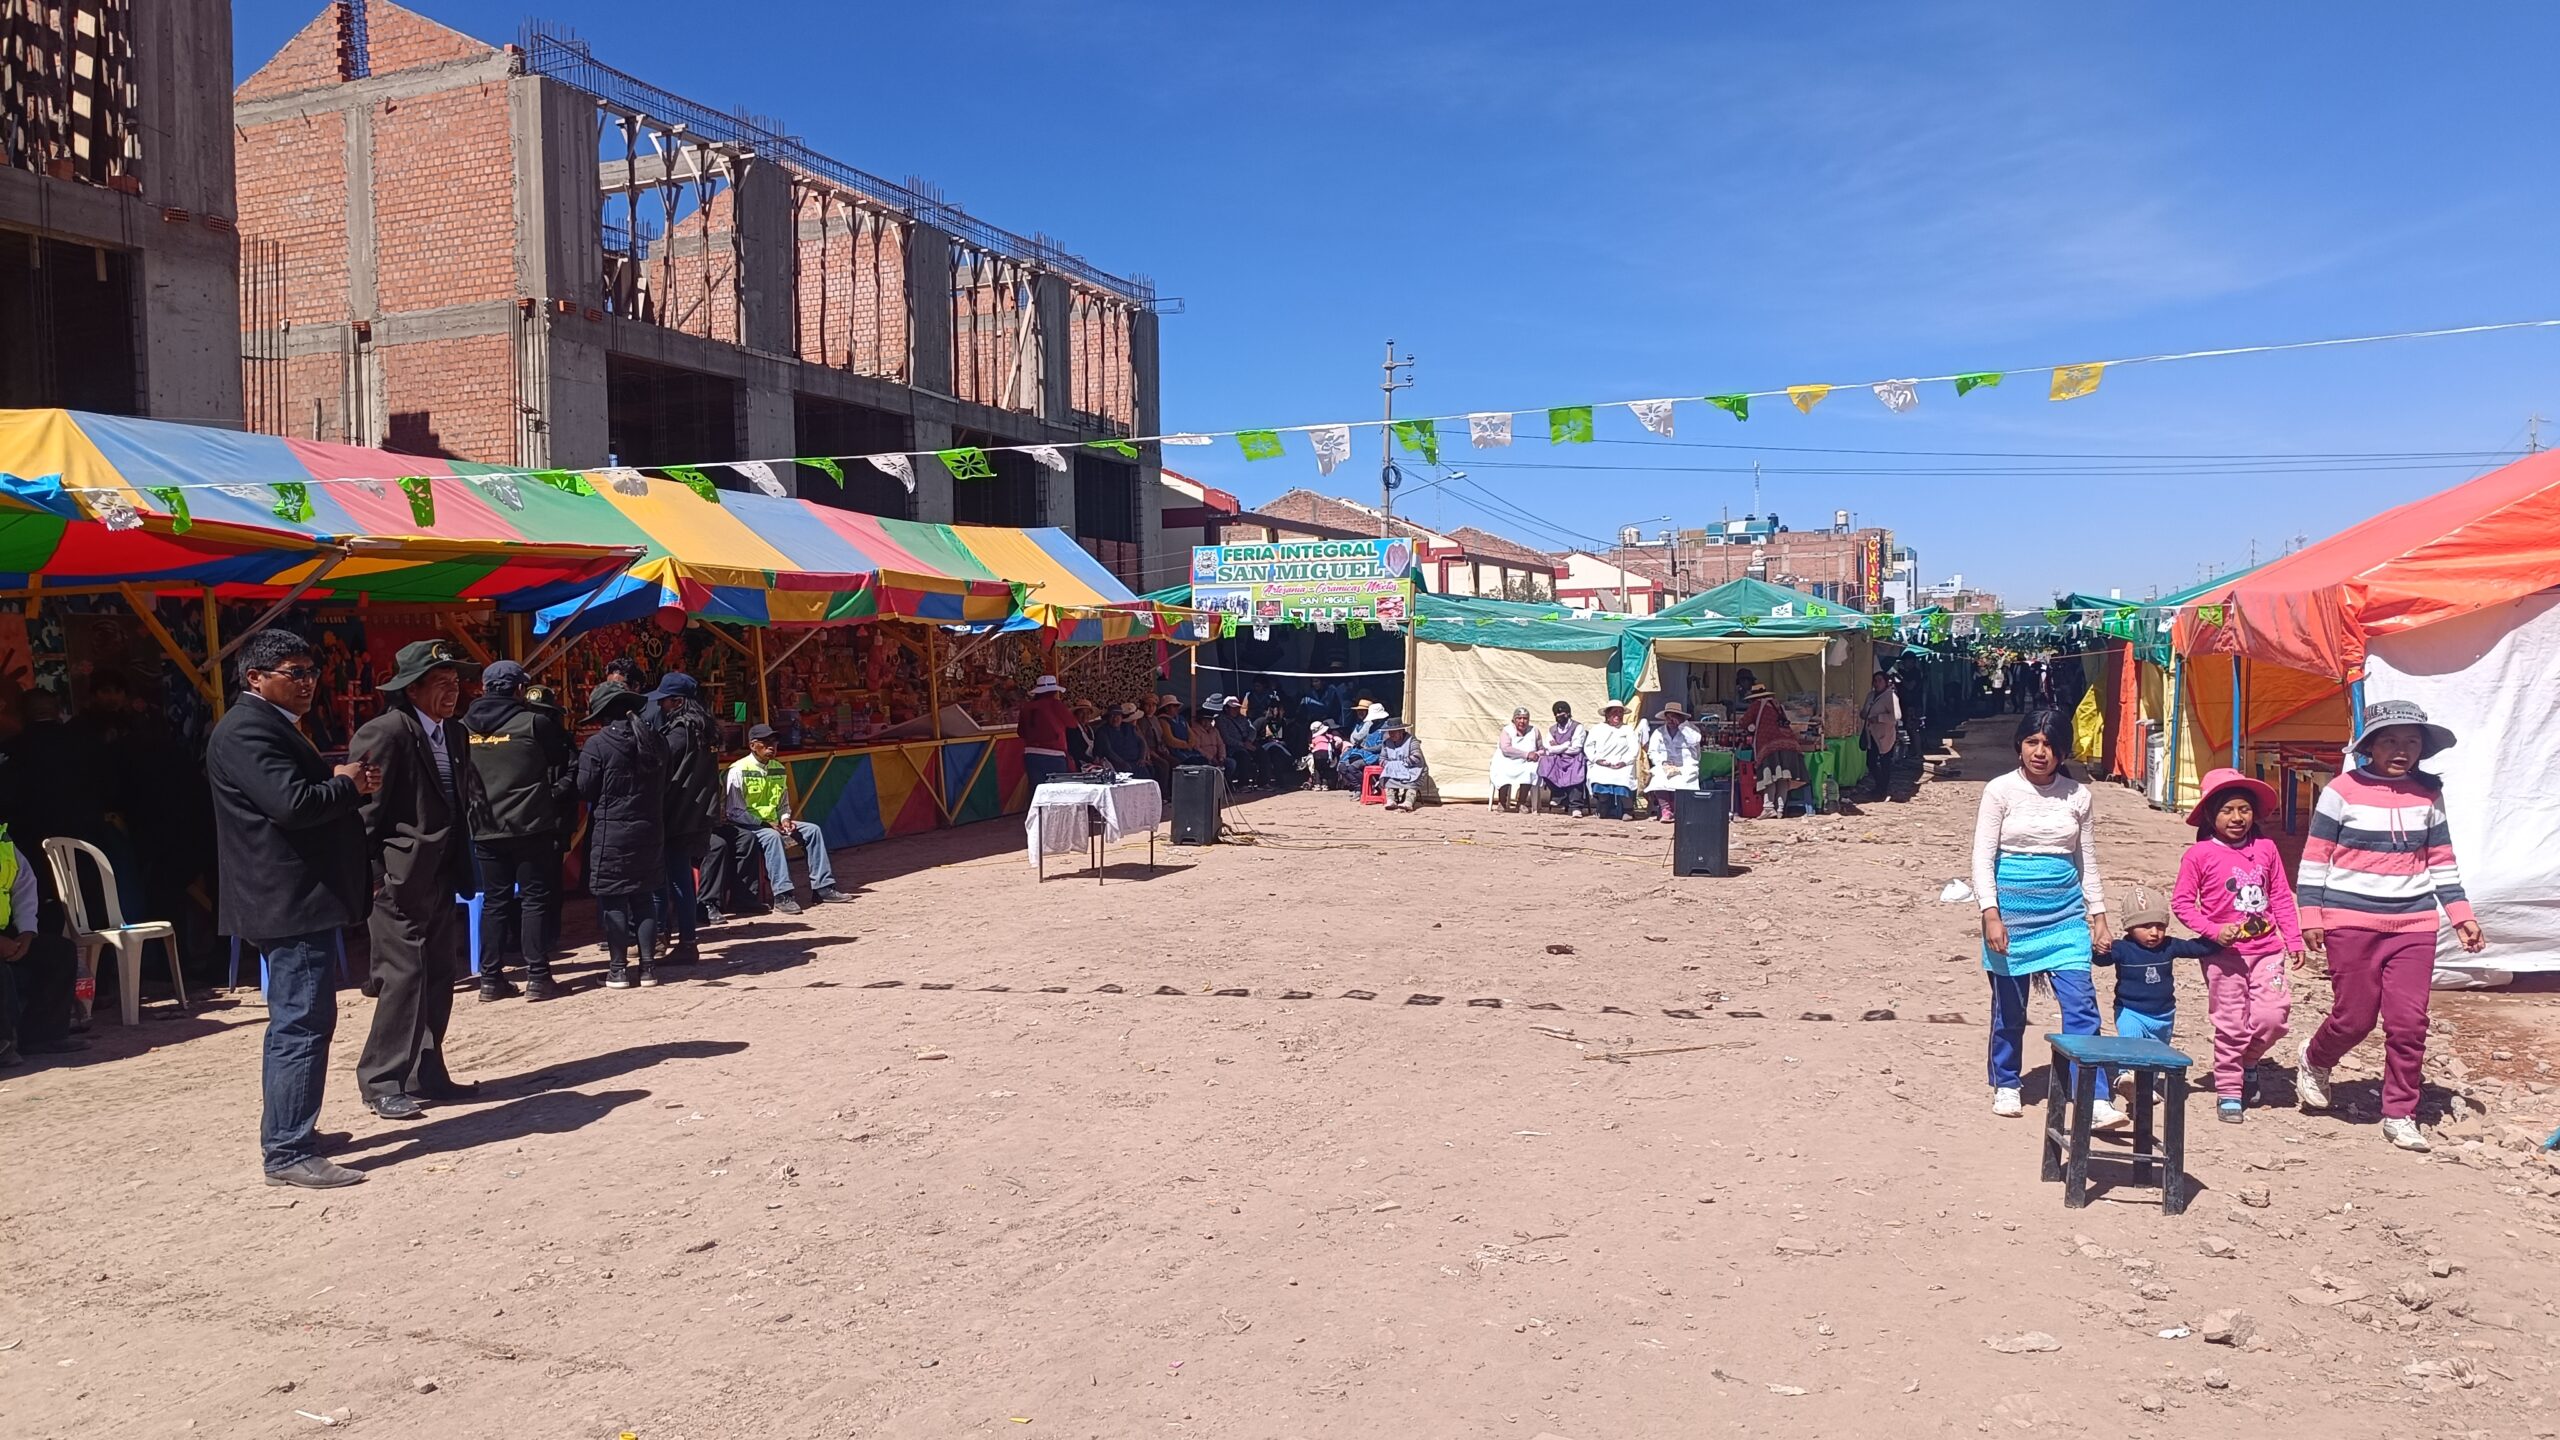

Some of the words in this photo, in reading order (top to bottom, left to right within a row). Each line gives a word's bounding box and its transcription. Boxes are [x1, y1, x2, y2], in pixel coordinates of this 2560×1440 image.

[1223, 548, 1274, 562] FERIA
[1280, 542, 1378, 560] INTEGRAL
[1218, 565, 1269, 582] SAN
[1275, 561, 1384, 580] MIGUEL
[1868, 540, 1877, 602] CHIFA
[1323, 595, 1358, 604] MIGUEL
